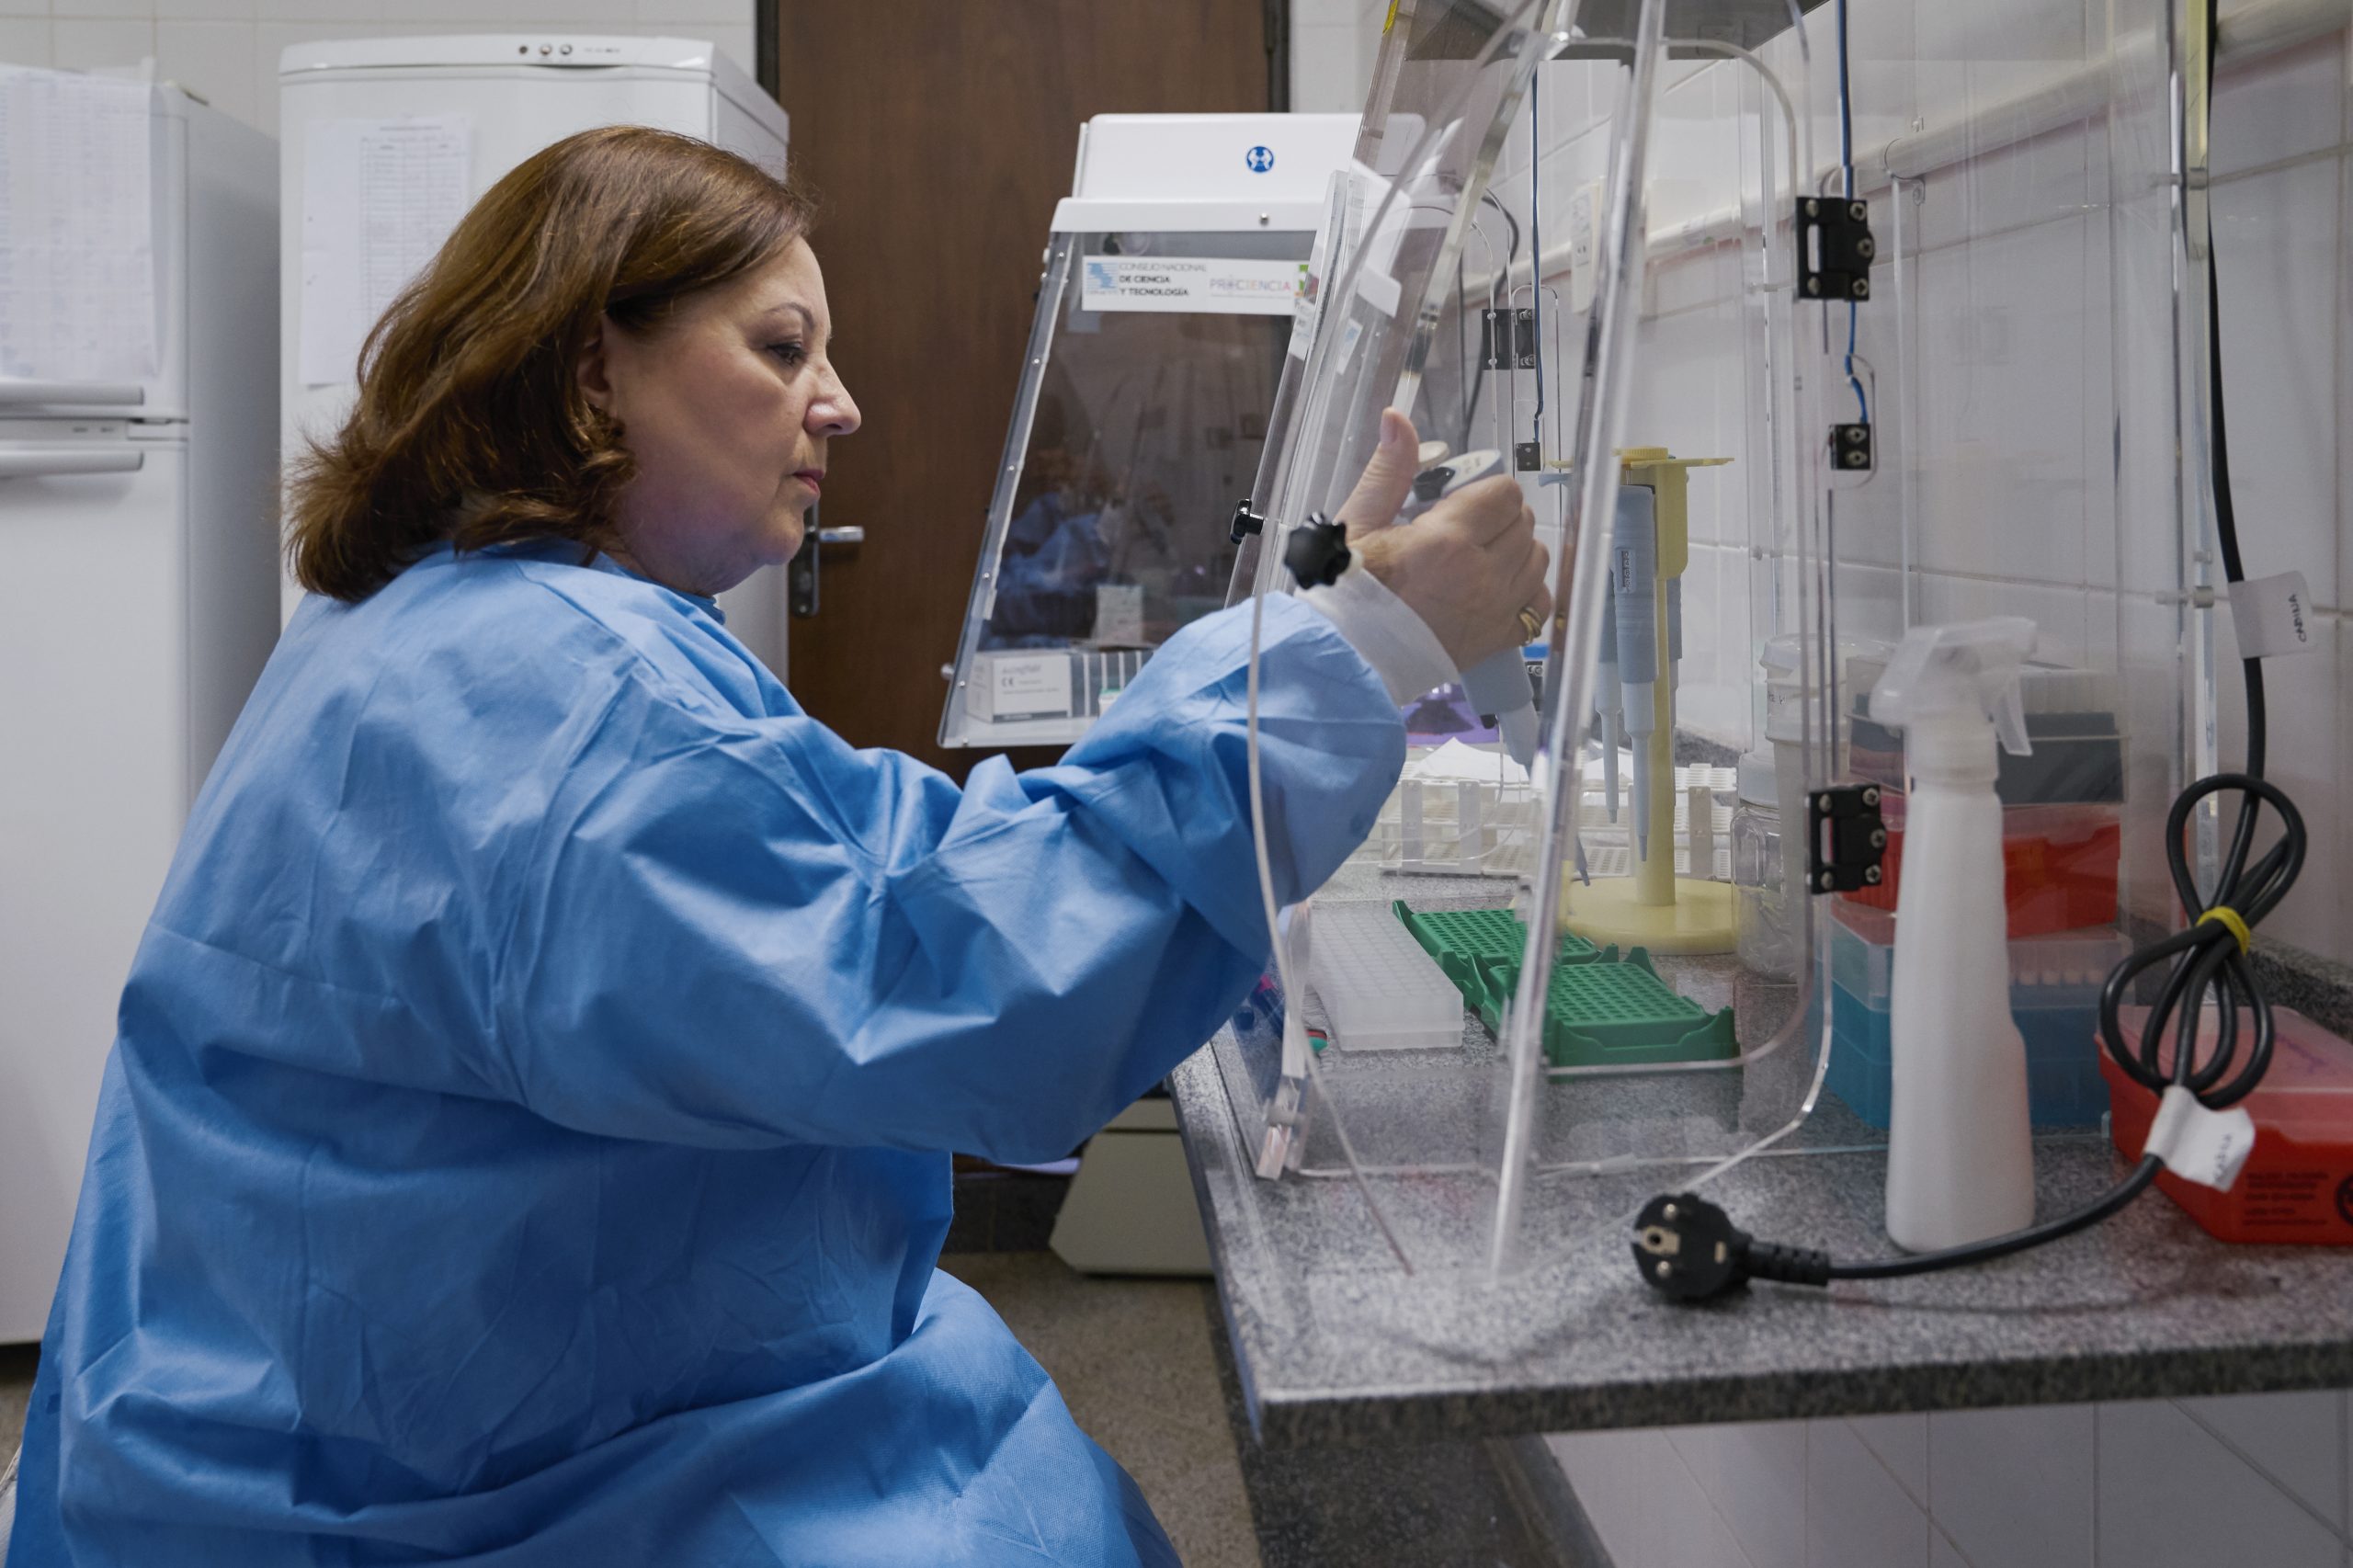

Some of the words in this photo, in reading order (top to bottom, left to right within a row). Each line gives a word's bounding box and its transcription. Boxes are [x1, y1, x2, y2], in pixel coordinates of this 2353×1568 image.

[1119, 263, 1160, 271] CONSEJO
[1162, 263, 1207, 272] NACIONAL
[1120, 288, 1126, 296] Y
